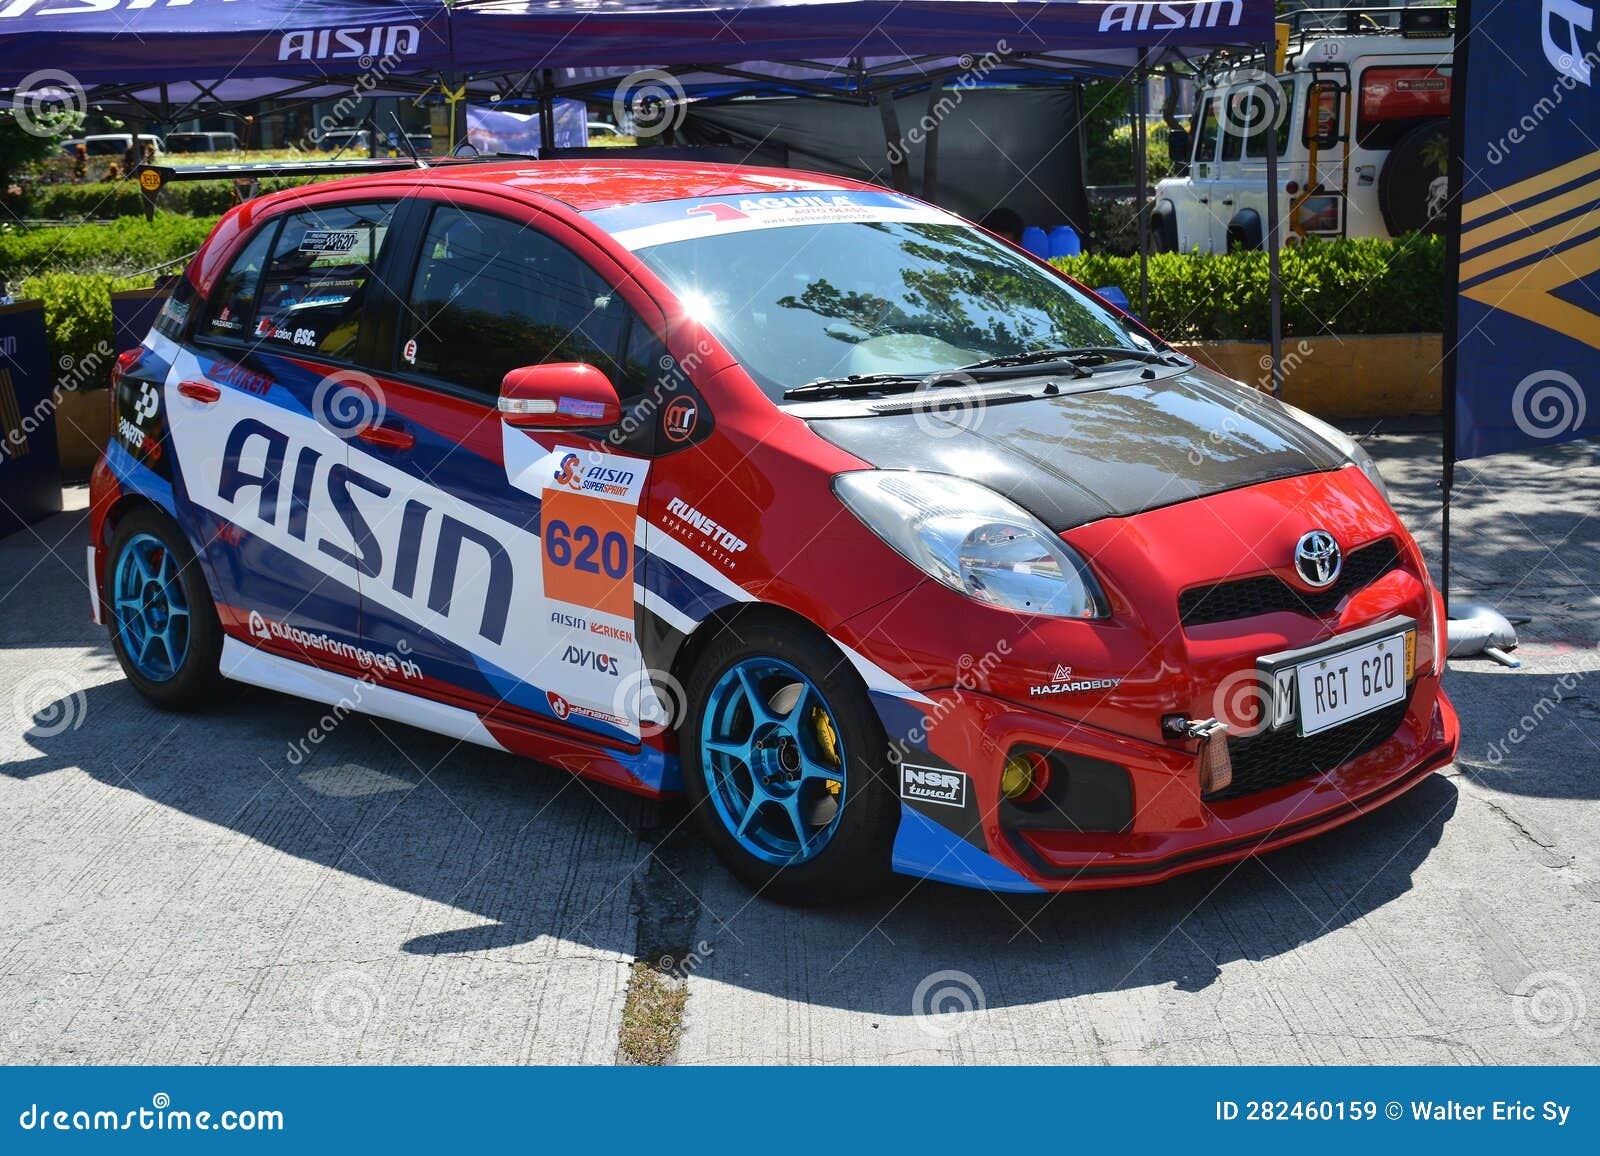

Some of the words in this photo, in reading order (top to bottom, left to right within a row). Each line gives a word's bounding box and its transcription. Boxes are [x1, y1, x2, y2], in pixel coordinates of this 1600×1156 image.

[1098, 0, 1243, 32] AISIN
[278, 25, 420, 61] AISIN
[739, 195, 857, 211] AGUILA
[582, 480, 630, 496] SUPERSPRINT
[587, 466, 634, 485] AISIN
[217, 417, 514, 646] AISIN
[662, 515, 694, 540] BRAKE
[666, 497, 748, 553] RUNSTOP
[546, 519, 628, 580] 620
[551, 612, 586, 630] AISIN
[603, 624, 632, 643] RIKEN
[270, 622, 398, 672] autoperformance
[401, 658, 424, 680] ph
[1030, 678, 1120, 695] HAZARDBOY
[1314, 666, 1349, 715] RGT
[1361, 652, 1394, 697] 620
[905, 769, 960, 789] NSR
[909, 784, 957, 800] tuned
